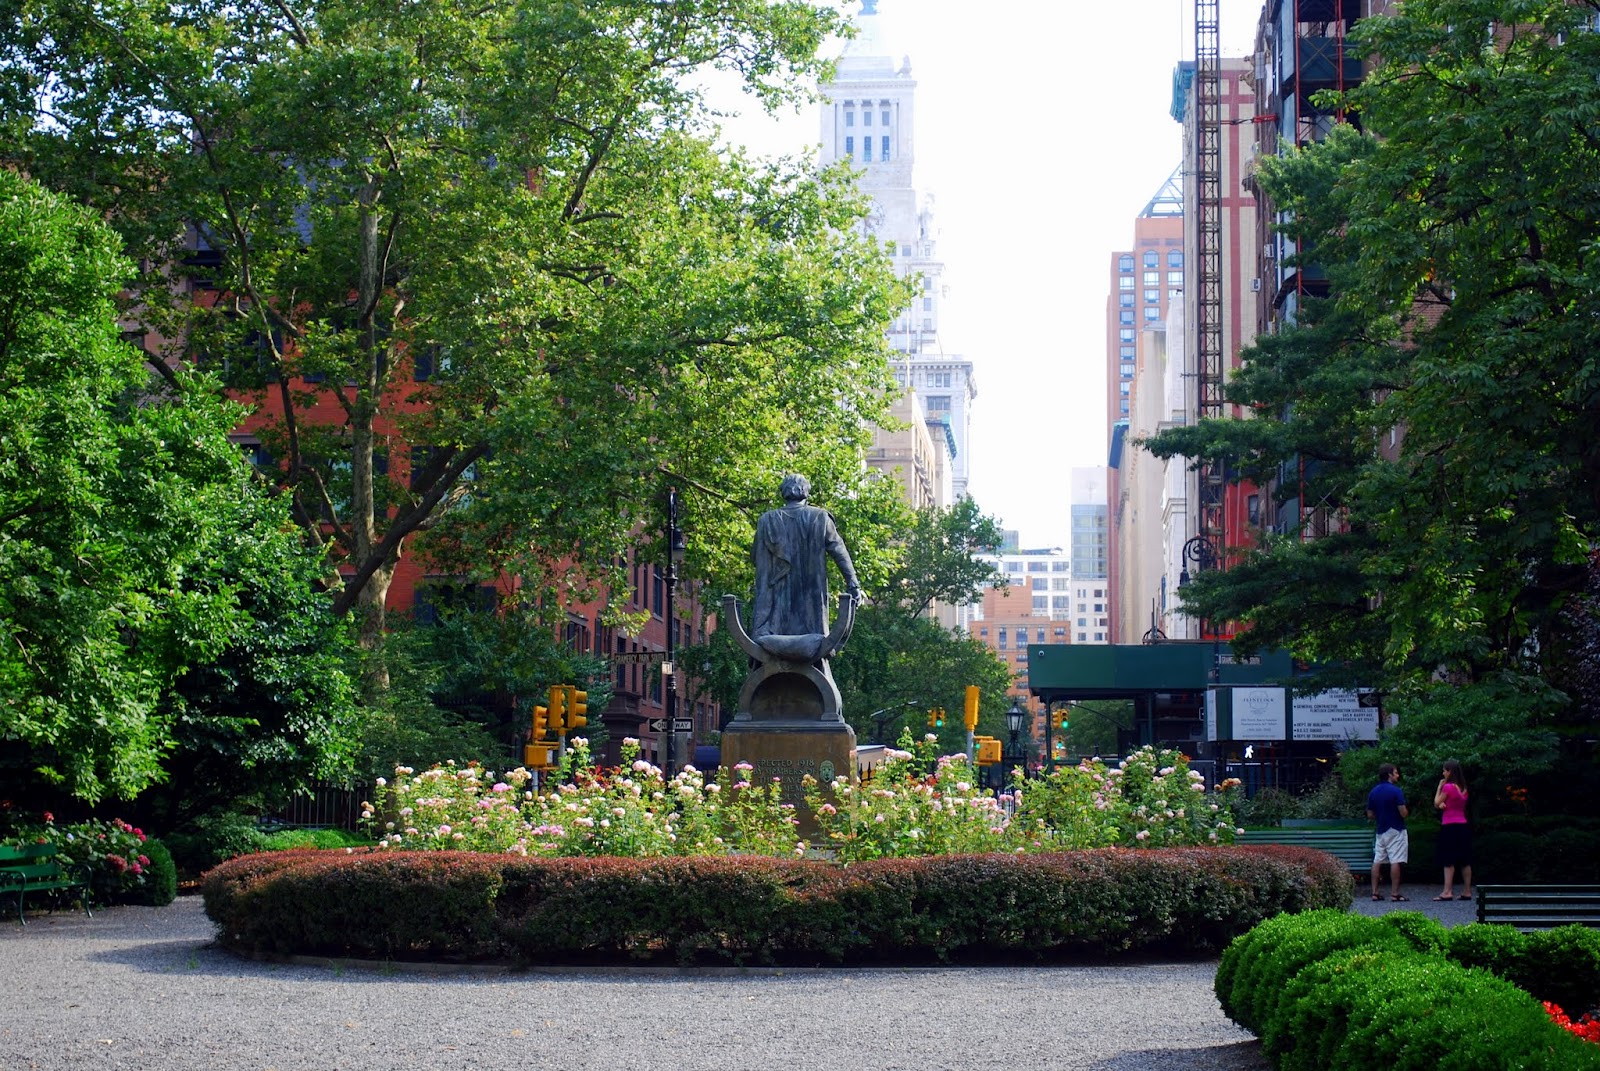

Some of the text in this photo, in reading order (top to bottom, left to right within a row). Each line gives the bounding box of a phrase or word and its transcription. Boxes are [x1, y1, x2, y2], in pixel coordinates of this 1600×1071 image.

[639, 653, 650, 662] PARK
[756, 759, 815, 767] ERECTED 1918
[753, 767, 816, 775] BY MEMBERS OF
